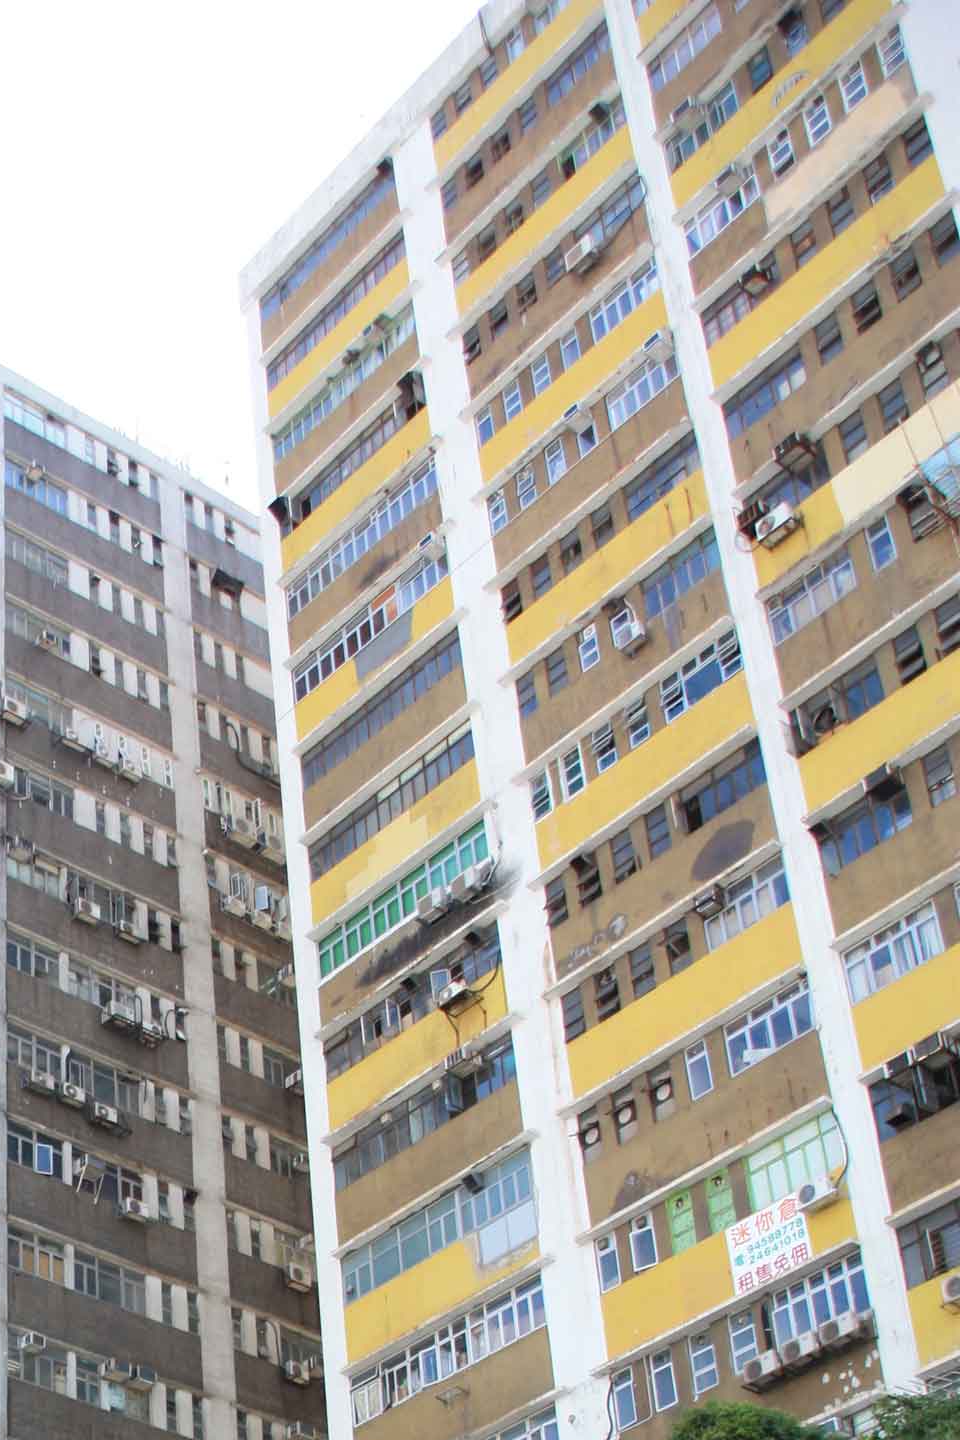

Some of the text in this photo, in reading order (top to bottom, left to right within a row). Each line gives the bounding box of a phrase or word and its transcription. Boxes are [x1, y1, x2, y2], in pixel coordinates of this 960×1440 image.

[730, 1198, 797, 1249] 迷你倉
[736, 1241, 809, 1296] 租售免佣
